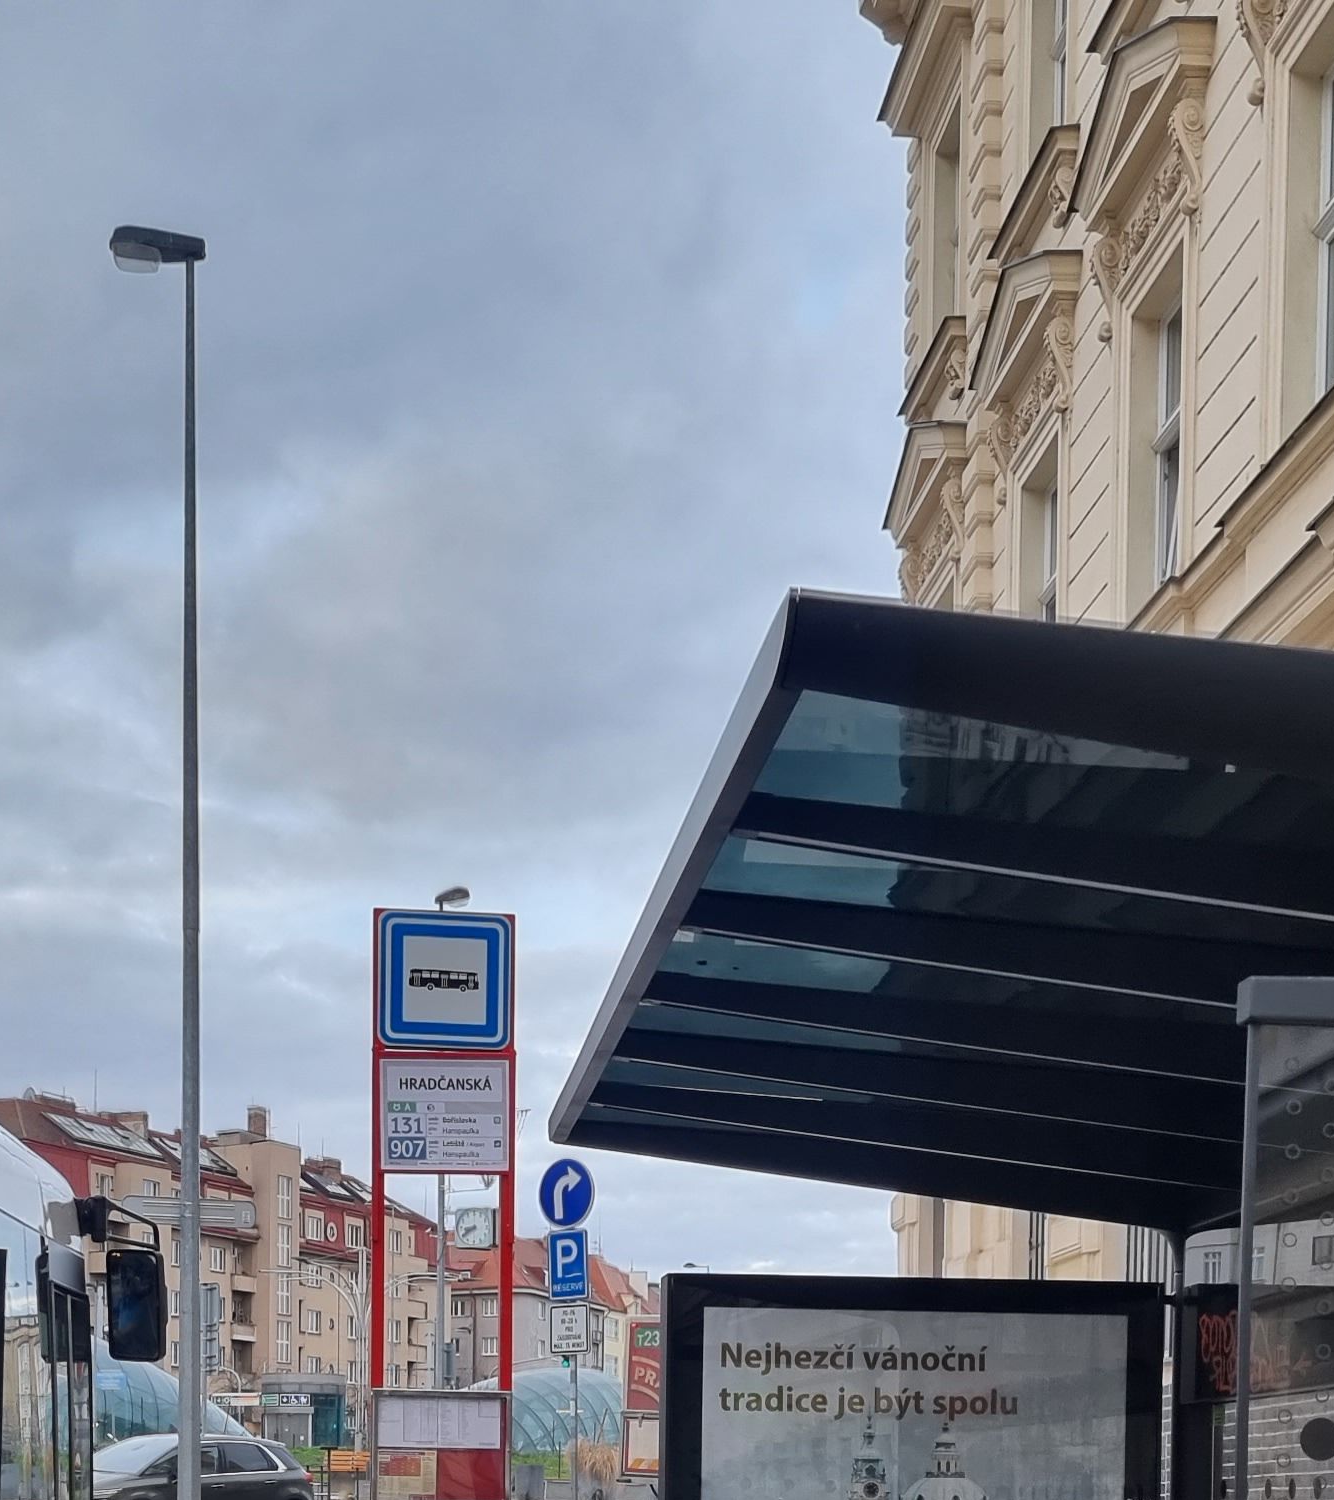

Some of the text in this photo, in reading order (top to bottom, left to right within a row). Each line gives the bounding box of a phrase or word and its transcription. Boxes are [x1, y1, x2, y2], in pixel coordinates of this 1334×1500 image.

[399, 1075, 493, 1091] HRADČANSKÁ
[391, 1117, 424, 1134] 131
[390, 1140, 425, 1158] 907
[556, 1239, 578, 1279] P
[720, 1342, 988, 1375] Nejhezčí vánoční
[719, 1386, 1019, 1421] tradice je být spolu
